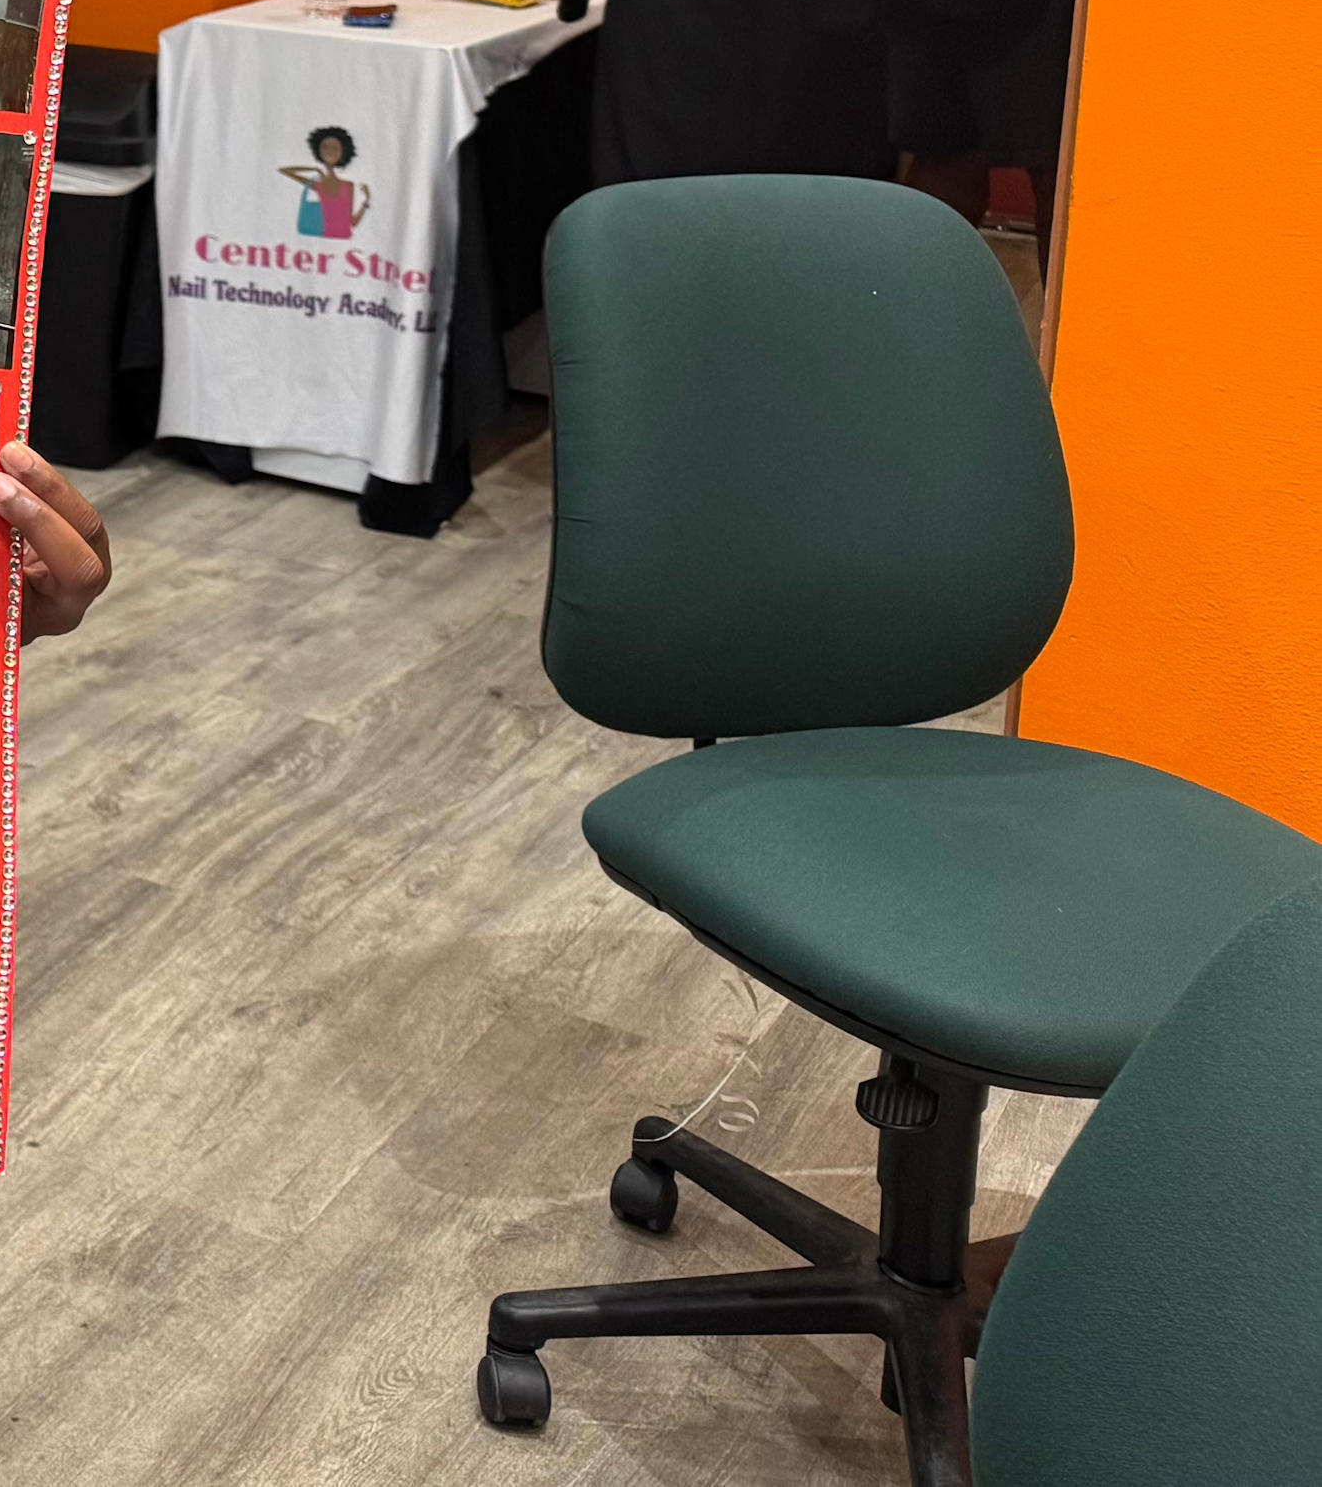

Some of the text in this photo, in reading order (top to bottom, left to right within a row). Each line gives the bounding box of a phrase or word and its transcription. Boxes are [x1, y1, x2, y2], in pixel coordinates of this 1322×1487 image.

[195, 233, 335, 276] Center
[167, 274, 208, 301] Nail
[211, 279, 331, 317] Technology
